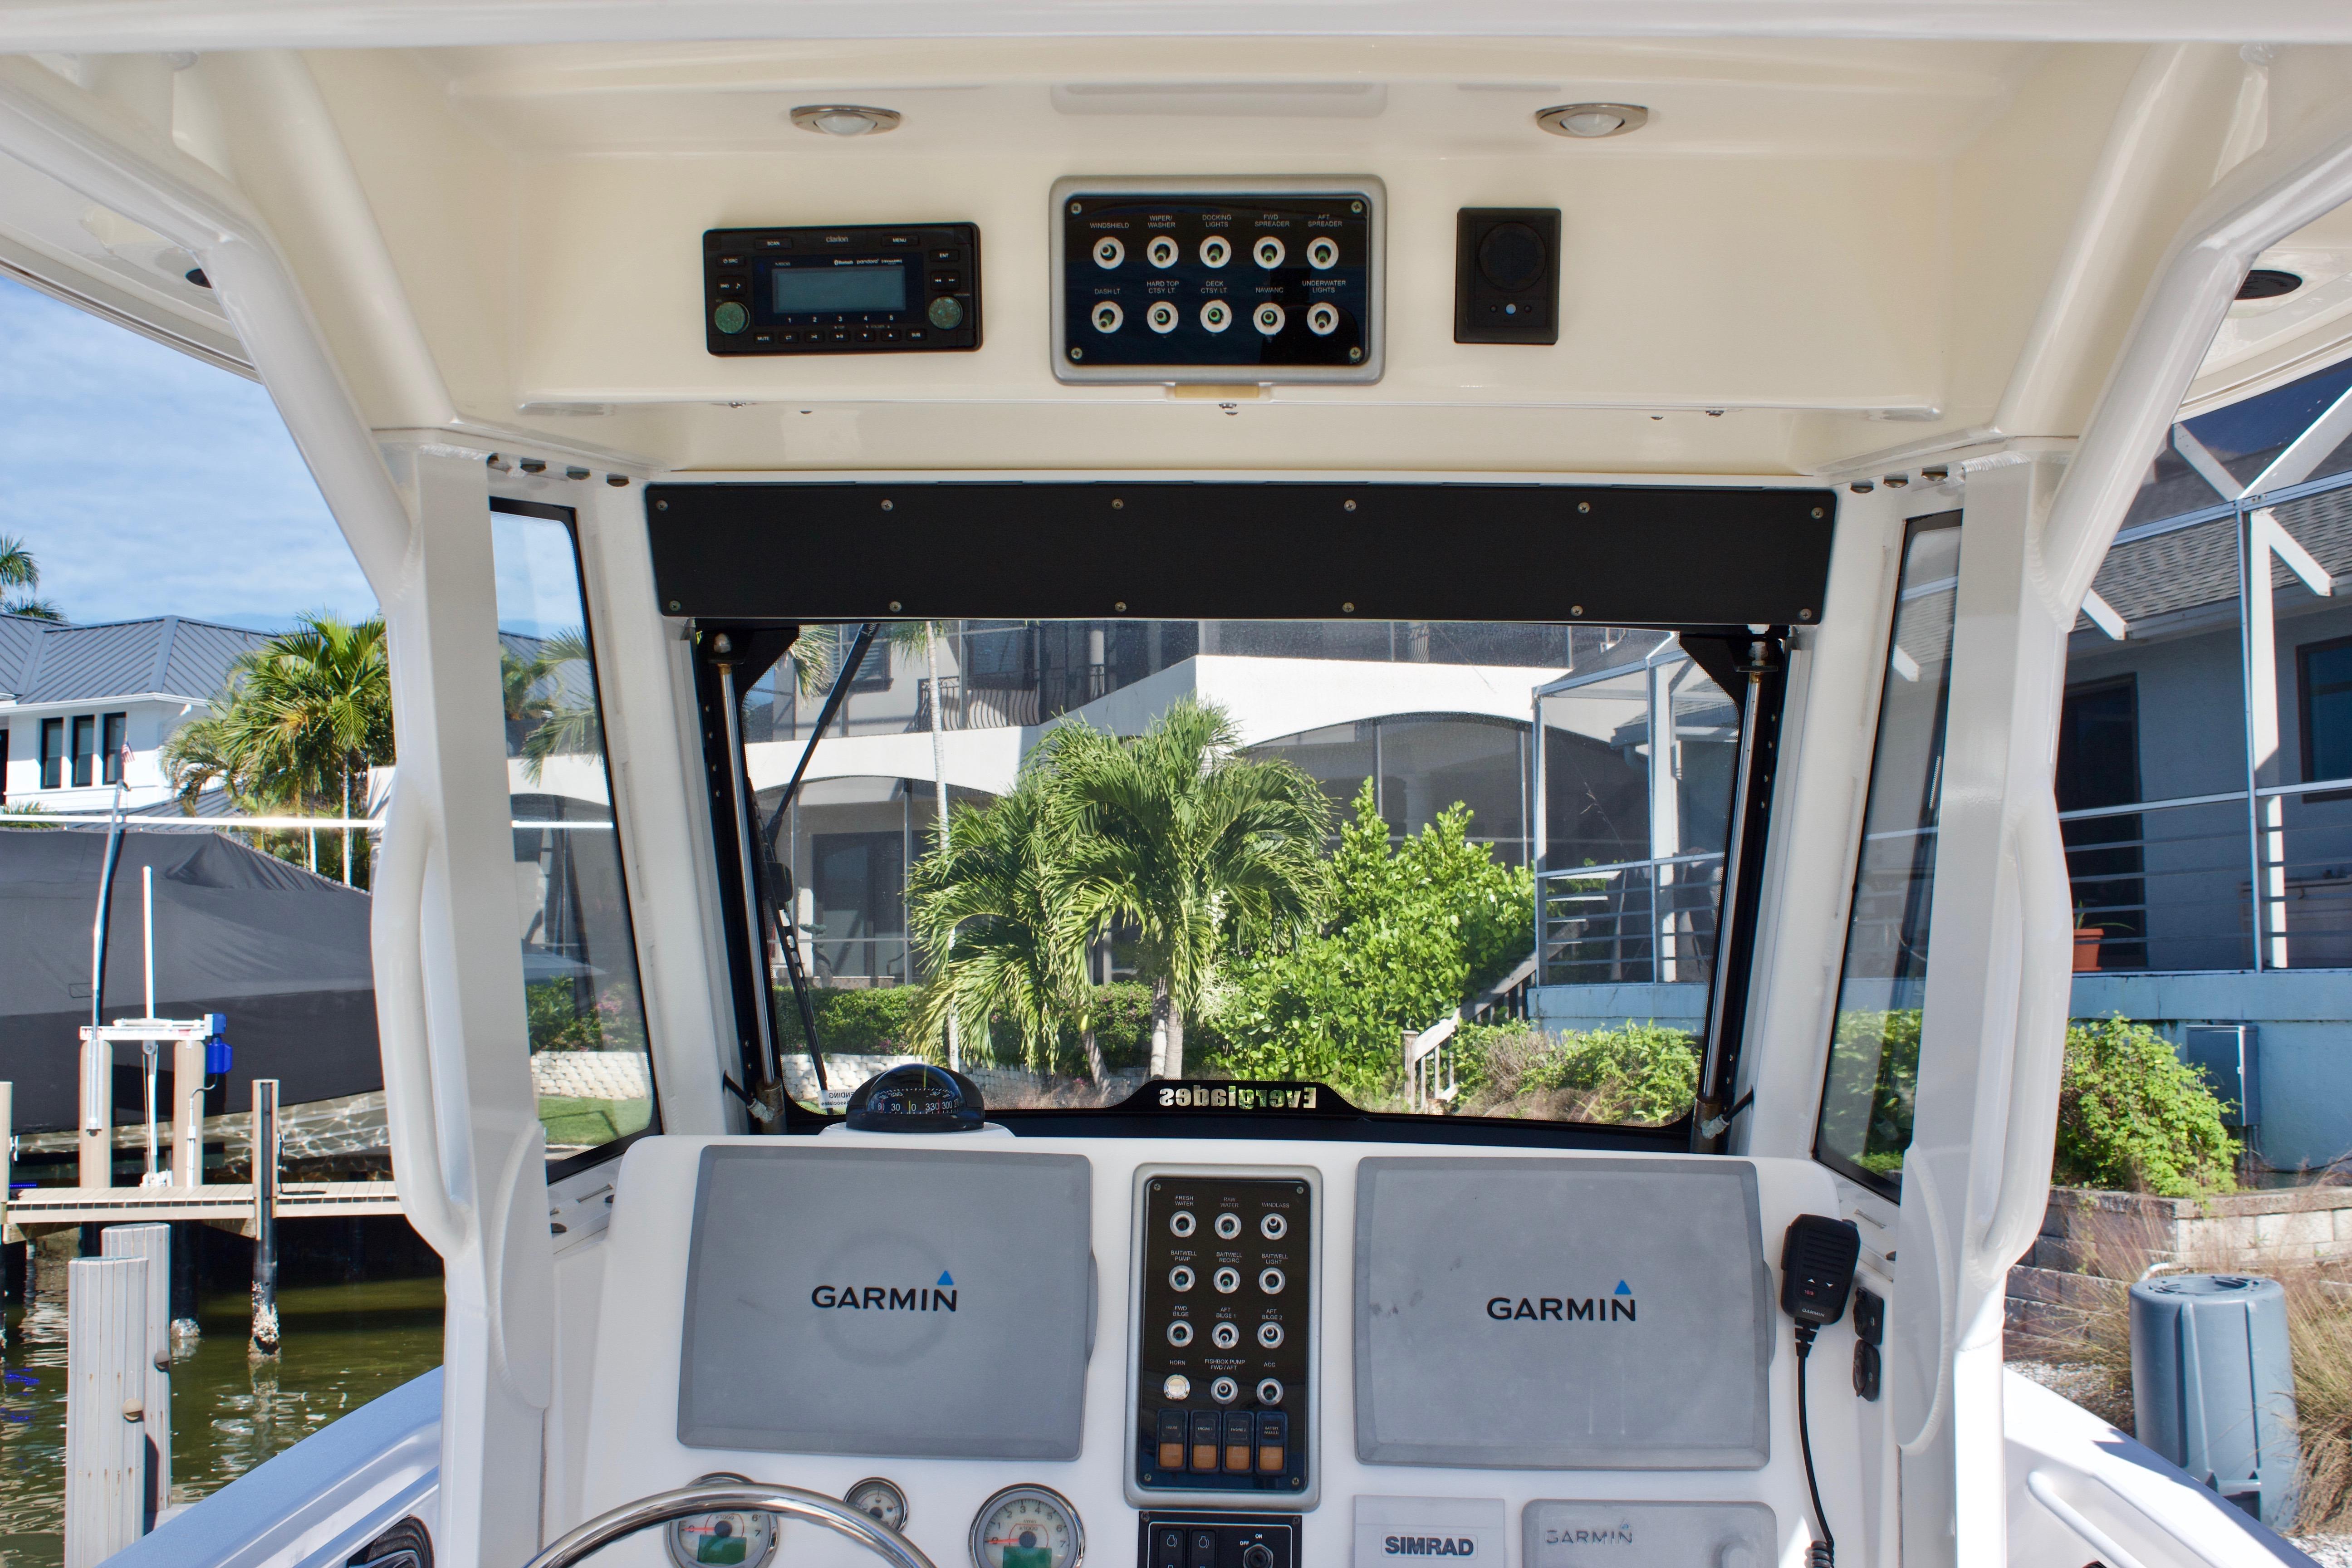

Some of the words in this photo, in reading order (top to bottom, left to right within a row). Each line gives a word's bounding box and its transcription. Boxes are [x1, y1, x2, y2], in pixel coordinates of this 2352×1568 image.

[812, 1285, 957, 1312] GARMIN
[1487, 1297, 1636, 1321] GARMIN
[1802, 1308, 1825, 1317] GARMIN
[1385, 1536, 1474, 1556] SIMRAD
